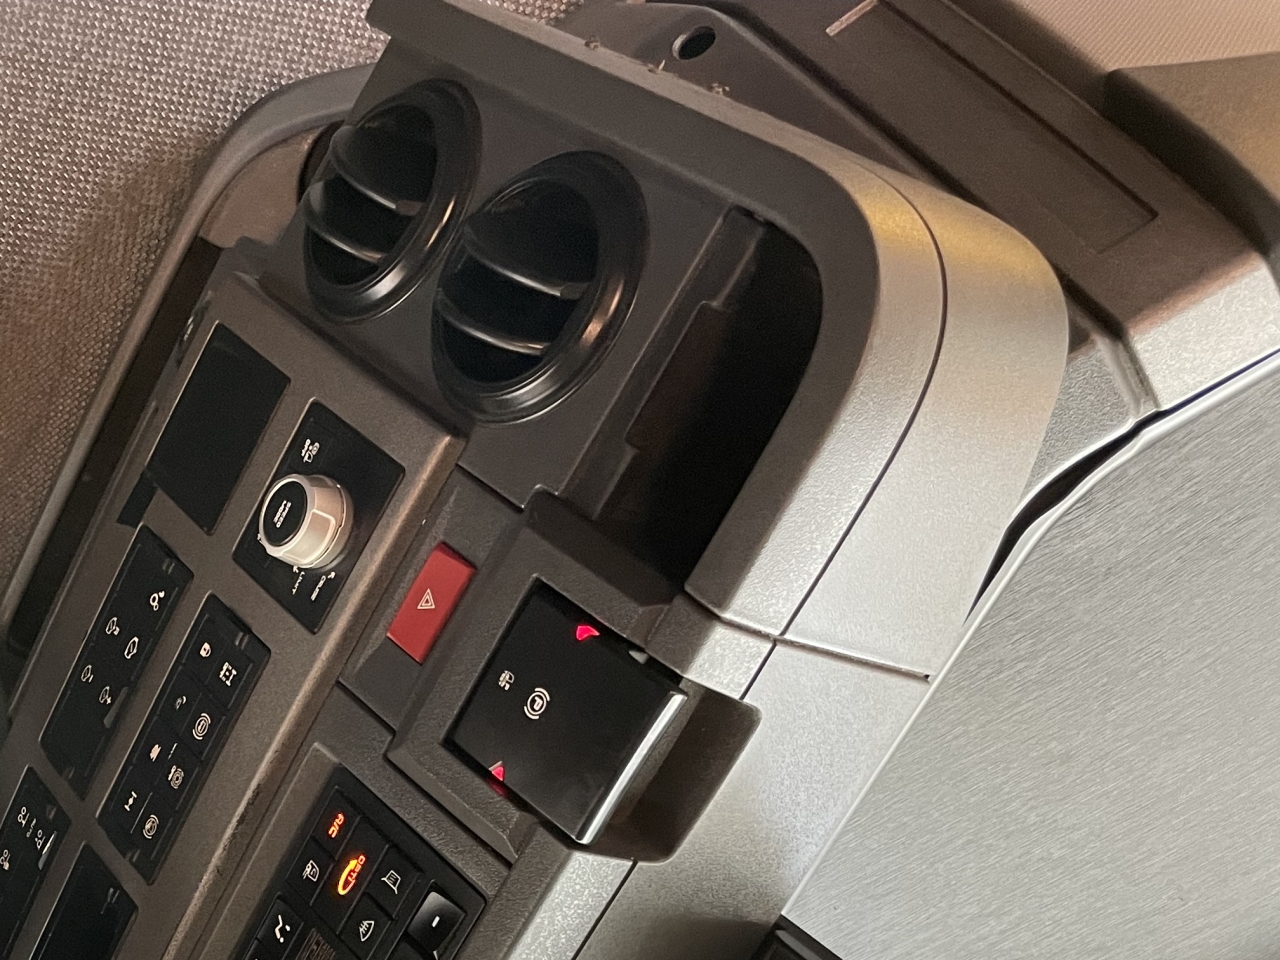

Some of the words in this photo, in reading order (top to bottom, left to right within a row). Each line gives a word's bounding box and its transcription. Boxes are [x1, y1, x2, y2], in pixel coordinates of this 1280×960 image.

[276, 501, 291, 528] SPEED
[291, 571, 306, 595] LIMIT
[328, 812, 345, 838] A/C
[347, 855, 366, 882] OPTI
